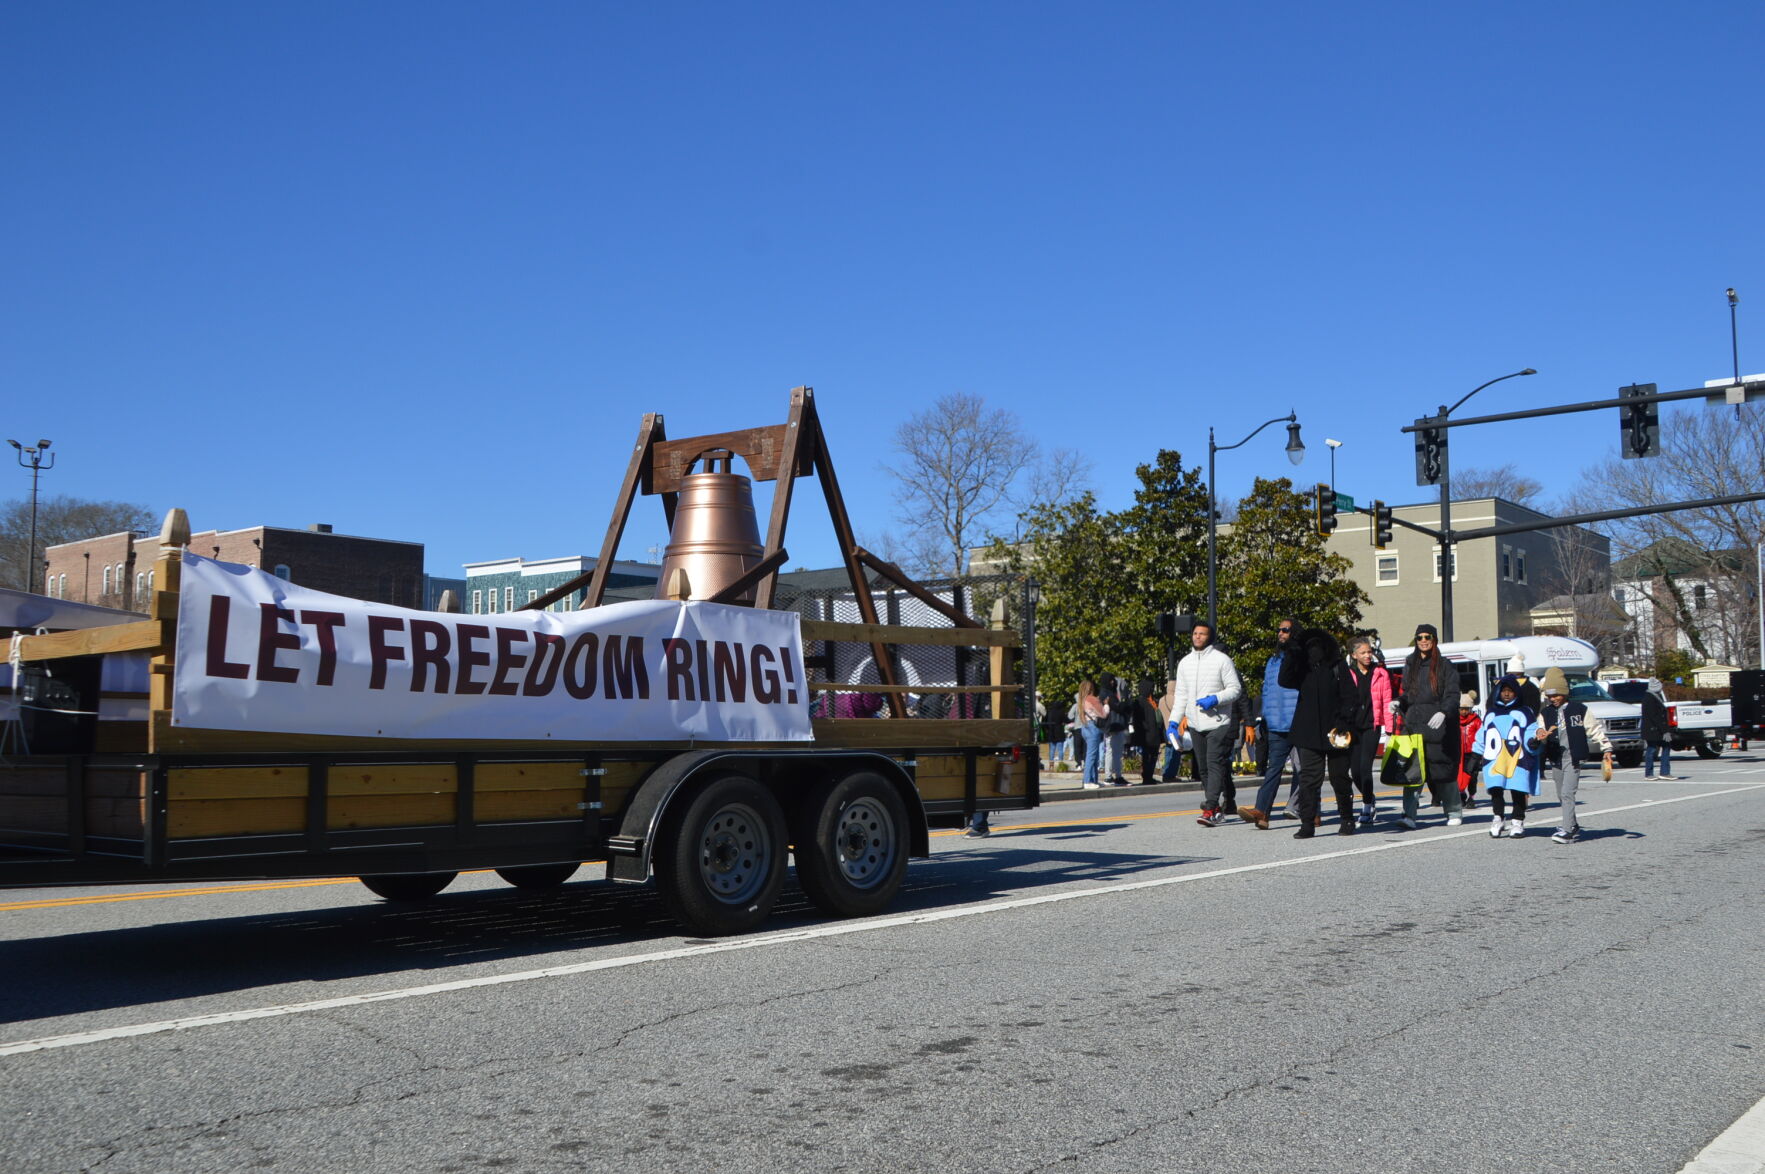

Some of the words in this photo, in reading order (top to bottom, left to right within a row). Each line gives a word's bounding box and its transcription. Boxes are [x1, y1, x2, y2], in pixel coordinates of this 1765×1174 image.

[206, 595, 346, 686] LET
[368, 615, 650, 700] FREEDOM
[662, 638, 798, 704] RING!
